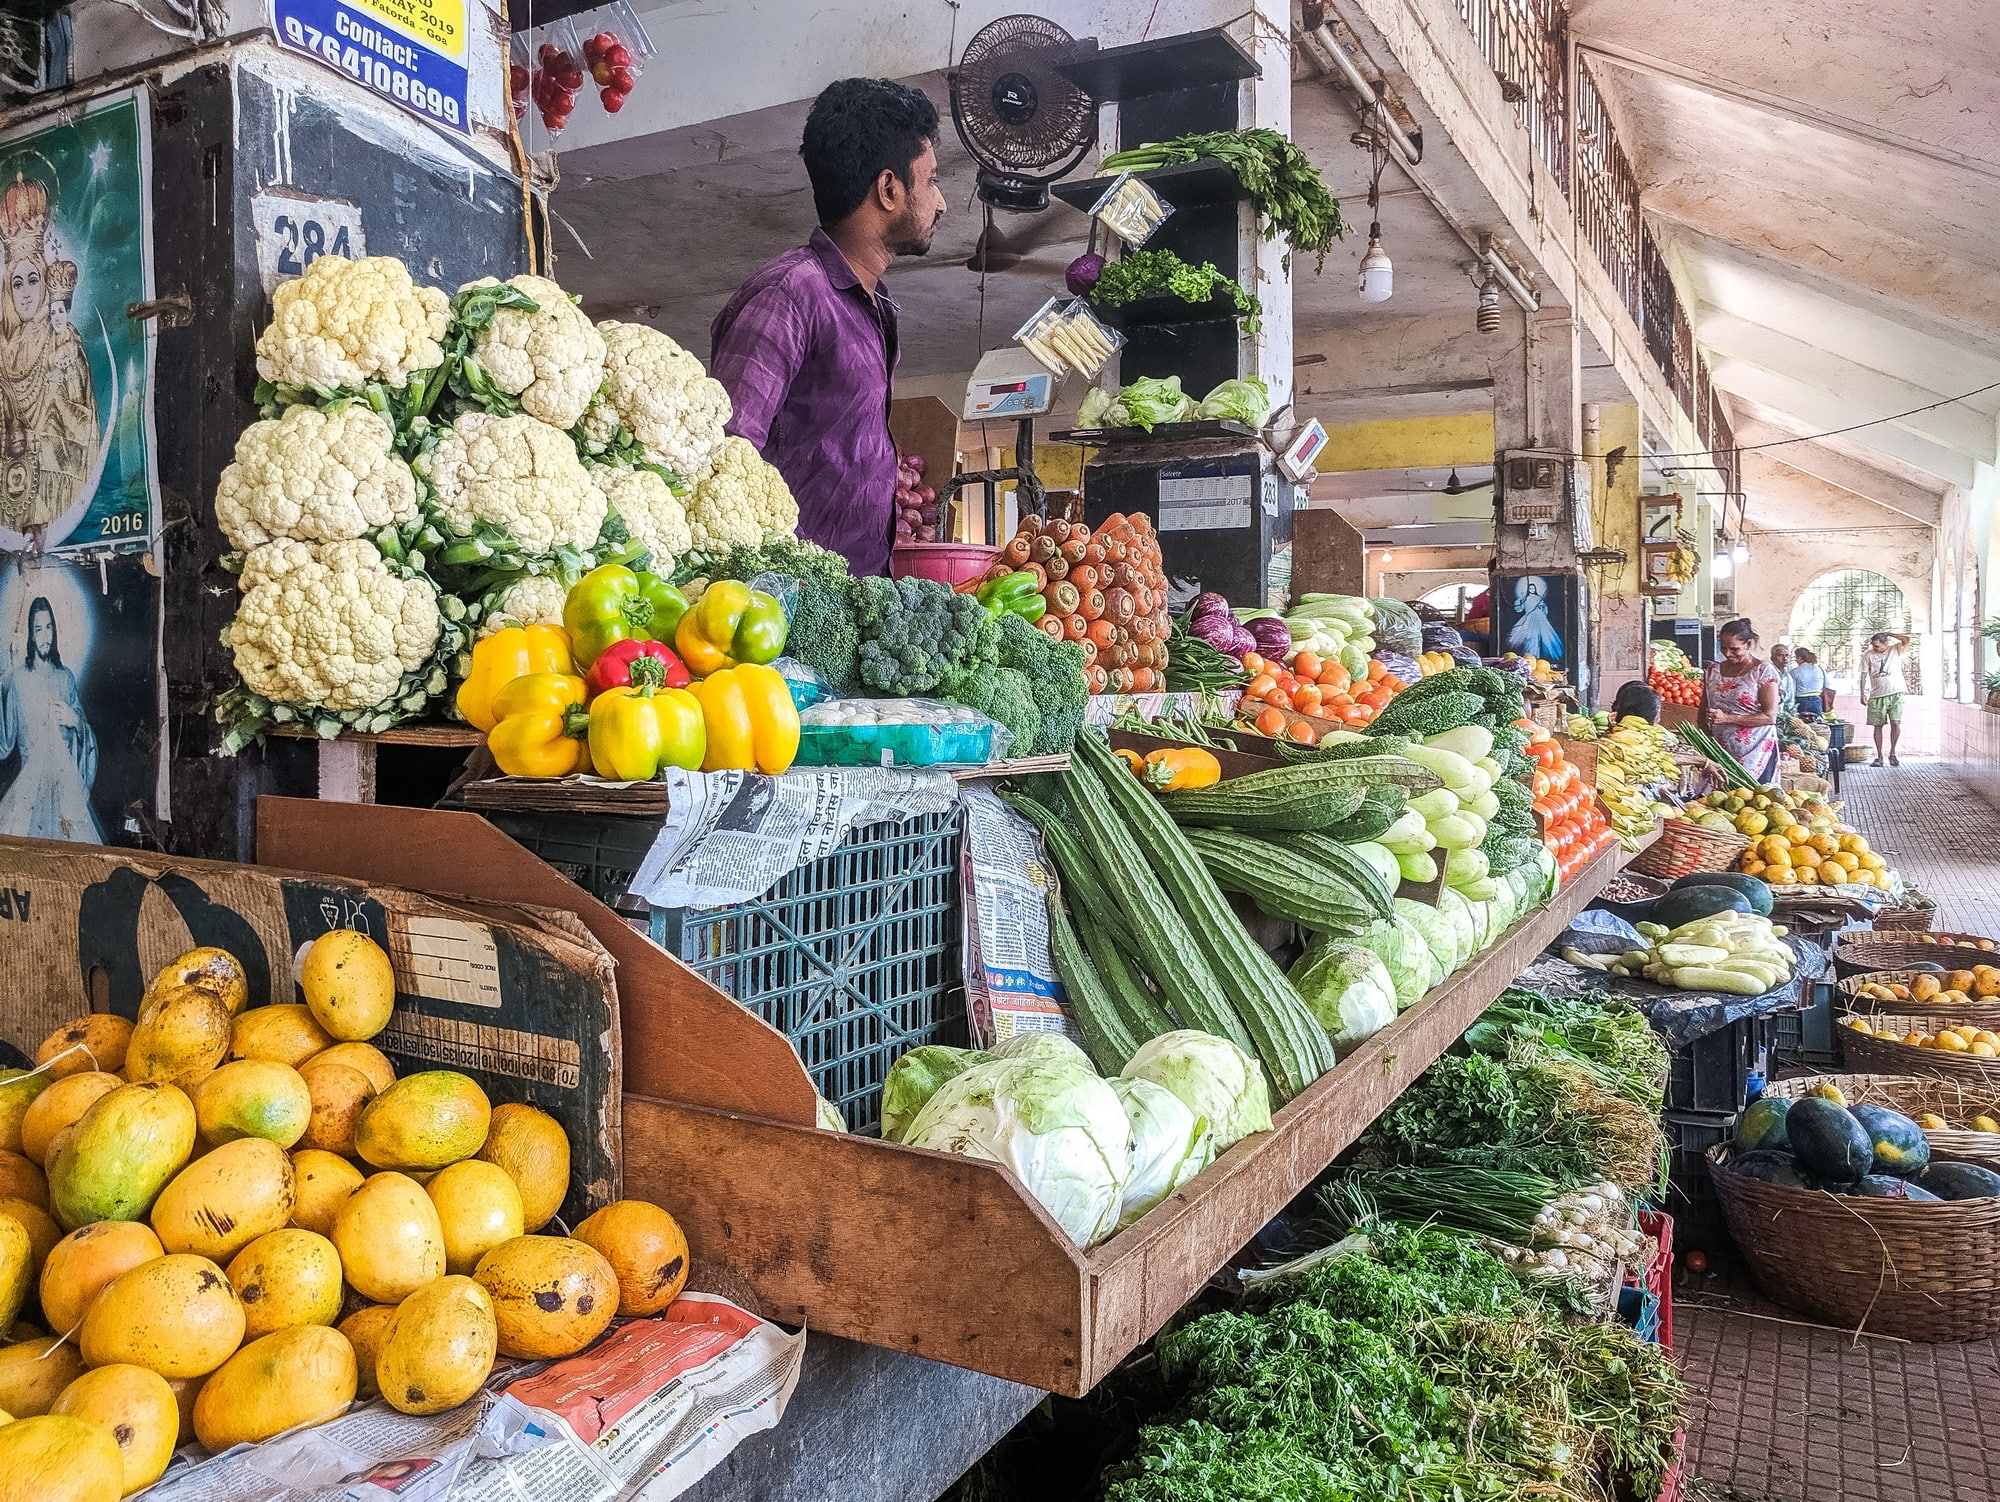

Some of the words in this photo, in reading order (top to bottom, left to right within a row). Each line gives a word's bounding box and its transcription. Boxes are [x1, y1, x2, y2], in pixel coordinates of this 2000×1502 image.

[372, 0, 415, 28] Fatorda
[427, 29, 447, 46] Goa
[389, 0, 416, 14] AY
[420, 10, 454, 35] 2019
[335, 11, 419, 72] Contact:
[284, 16, 460, 125] 9764108699
[1226, 498, 1243, 506] 2017
[101, 512, 143, 536] 2016
[795, 838, 814, 869] इल
[386, 1035, 403, 1051] 180
[406, 1040, 421, 1054] 165
[423, 1043, 440, 1058] 150
[442, 1046, 459, 1063] 135
[460, 1050, 479, 1066] 120
[482, 1054, 499, 1072] 110
[500, 1058, 520, 1076] 100
[541, 1065, 556, 1082] 80
[561, 1069, 576, 1086] 70
[605, 1432, 639, 1461] AUTHORISED
[635, 1421, 649, 1435] FORD
